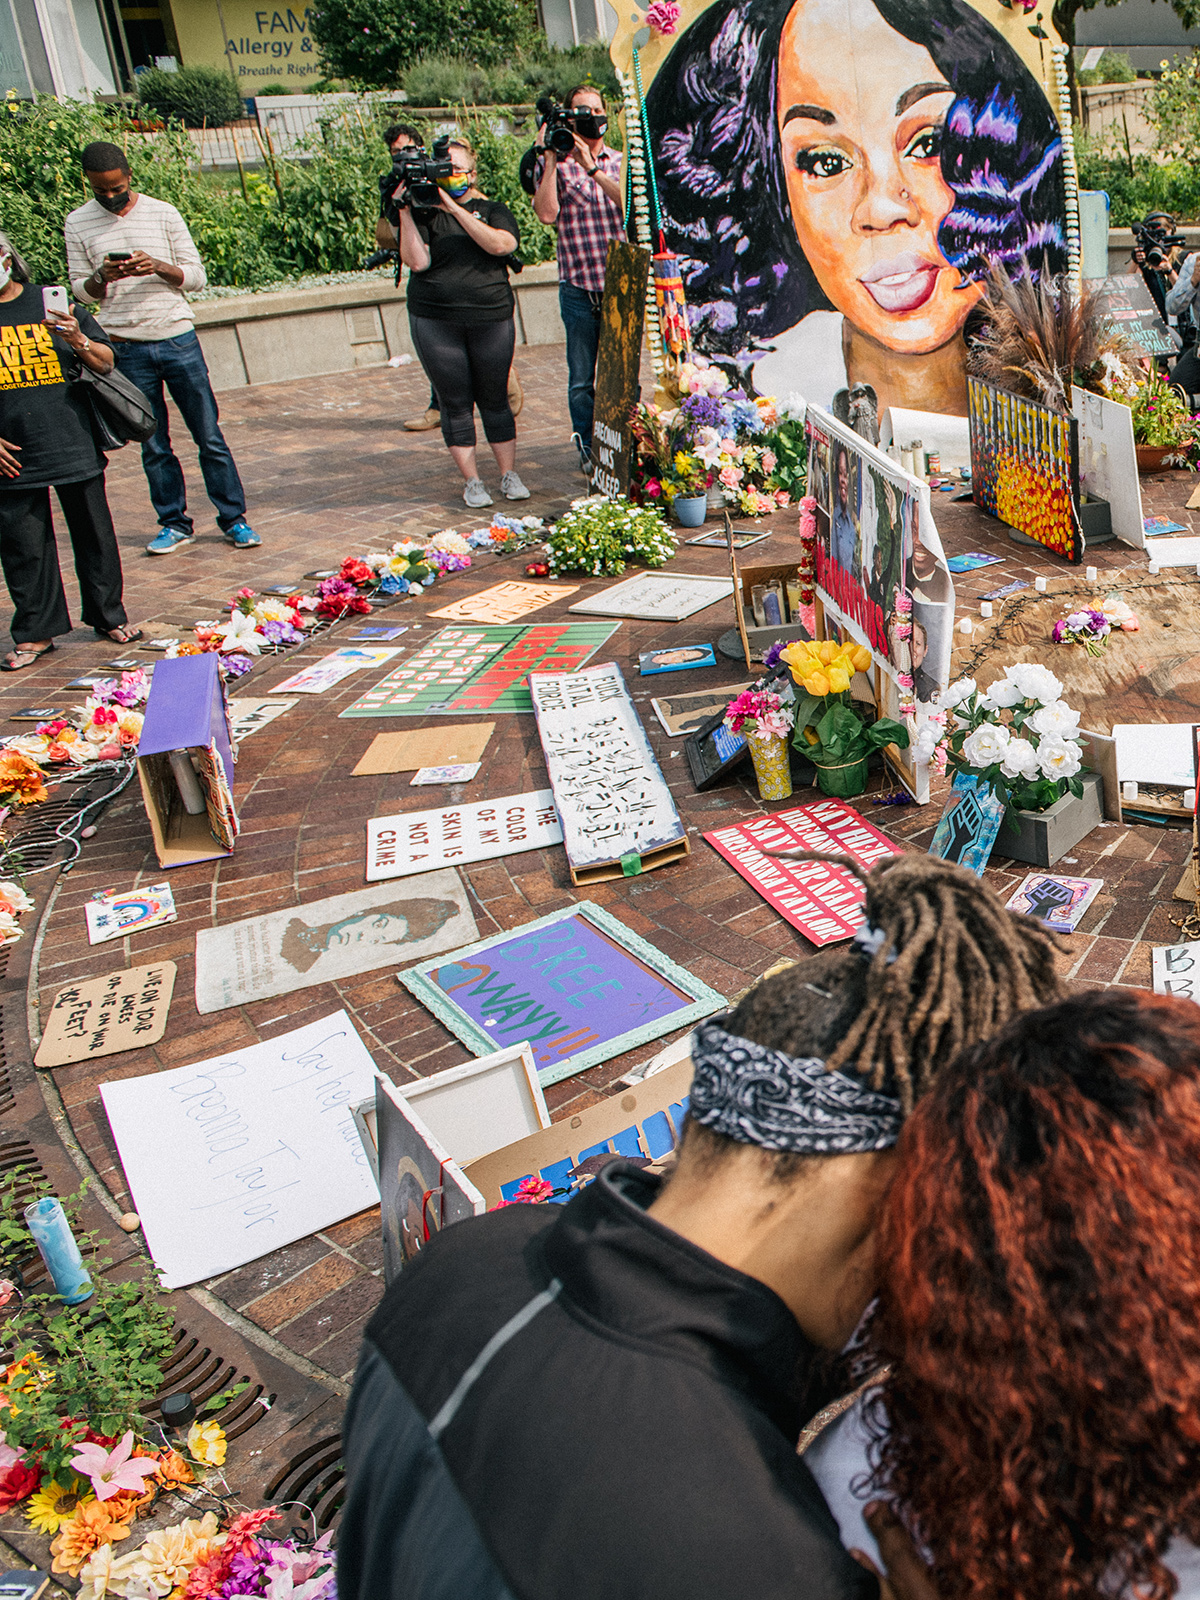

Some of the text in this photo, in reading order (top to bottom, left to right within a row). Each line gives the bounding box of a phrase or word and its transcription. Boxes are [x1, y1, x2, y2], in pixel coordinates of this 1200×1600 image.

[224, 37, 312, 58] Allergy &
[238, 64, 283, 76] Breathe
[968, 380, 1071, 464] NO JUSTICE
[436, 642, 505, 684] Real
[446, 625, 571, 710] RESERVE
[536, 680, 566, 712] FORCE
[564, 676, 595, 708] FATAL
[592, 675, 624, 703] FUCK
[477, 808, 500, 844] OF MY
[506, 806, 527, 843] COLOR
[535, 805, 558, 827] THE
[805, 801, 860, 831] SAY
[375, 829, 397, 867] CRIME
[408, 821, 429, 862] NOT A
[441, 811, 463, 858] SKIN IS
[743, 818, 798, 849] SAY
[712, 827, 788, 890] BREONNA
[772, 883, 847, 941] TAYLOR
[107, 976, 122, 990] OR
[499, 922, 624, 1010] BREE
[101, 991, 117, 1008] DIE
[118, 993, 138, 1024] KNEES
[140, 989, 161, 1004] ON
[64, 1000, 92, 1038] FEET?
[98, 1012, 110, 1027] ON
[272, 1031, 347, 1091] Say
[315, 1071, 354, 1114] her
[190, 1139, 301, 1230] Taylor
